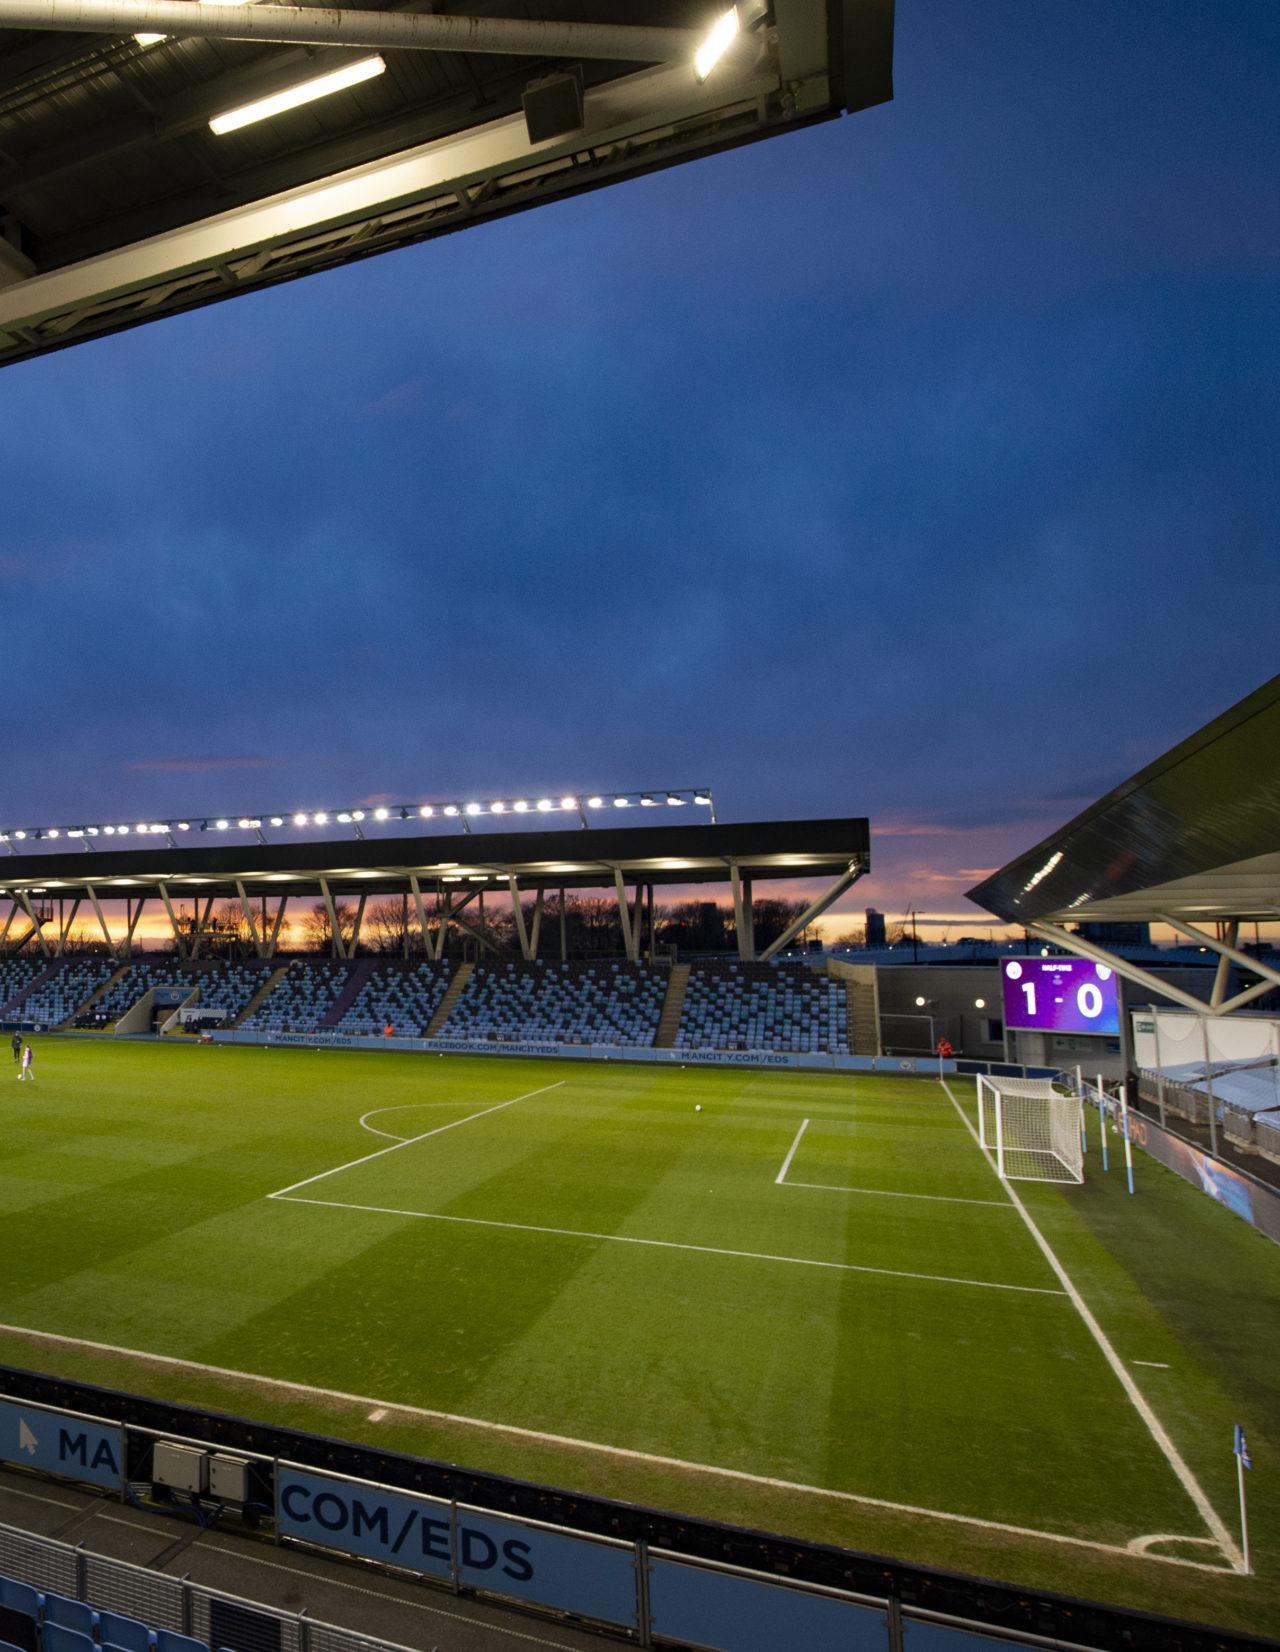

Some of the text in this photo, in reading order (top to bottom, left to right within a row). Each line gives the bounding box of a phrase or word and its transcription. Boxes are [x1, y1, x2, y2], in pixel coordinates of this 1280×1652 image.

[1022, 982, 1037, 1015] 1
[1076, 983, 1103, 1018] 0
[275, 1034, 352, 1046] MANCITY.COM/EDS
[681, 1052, 789, 1064] MANCITY.COM/EDS
